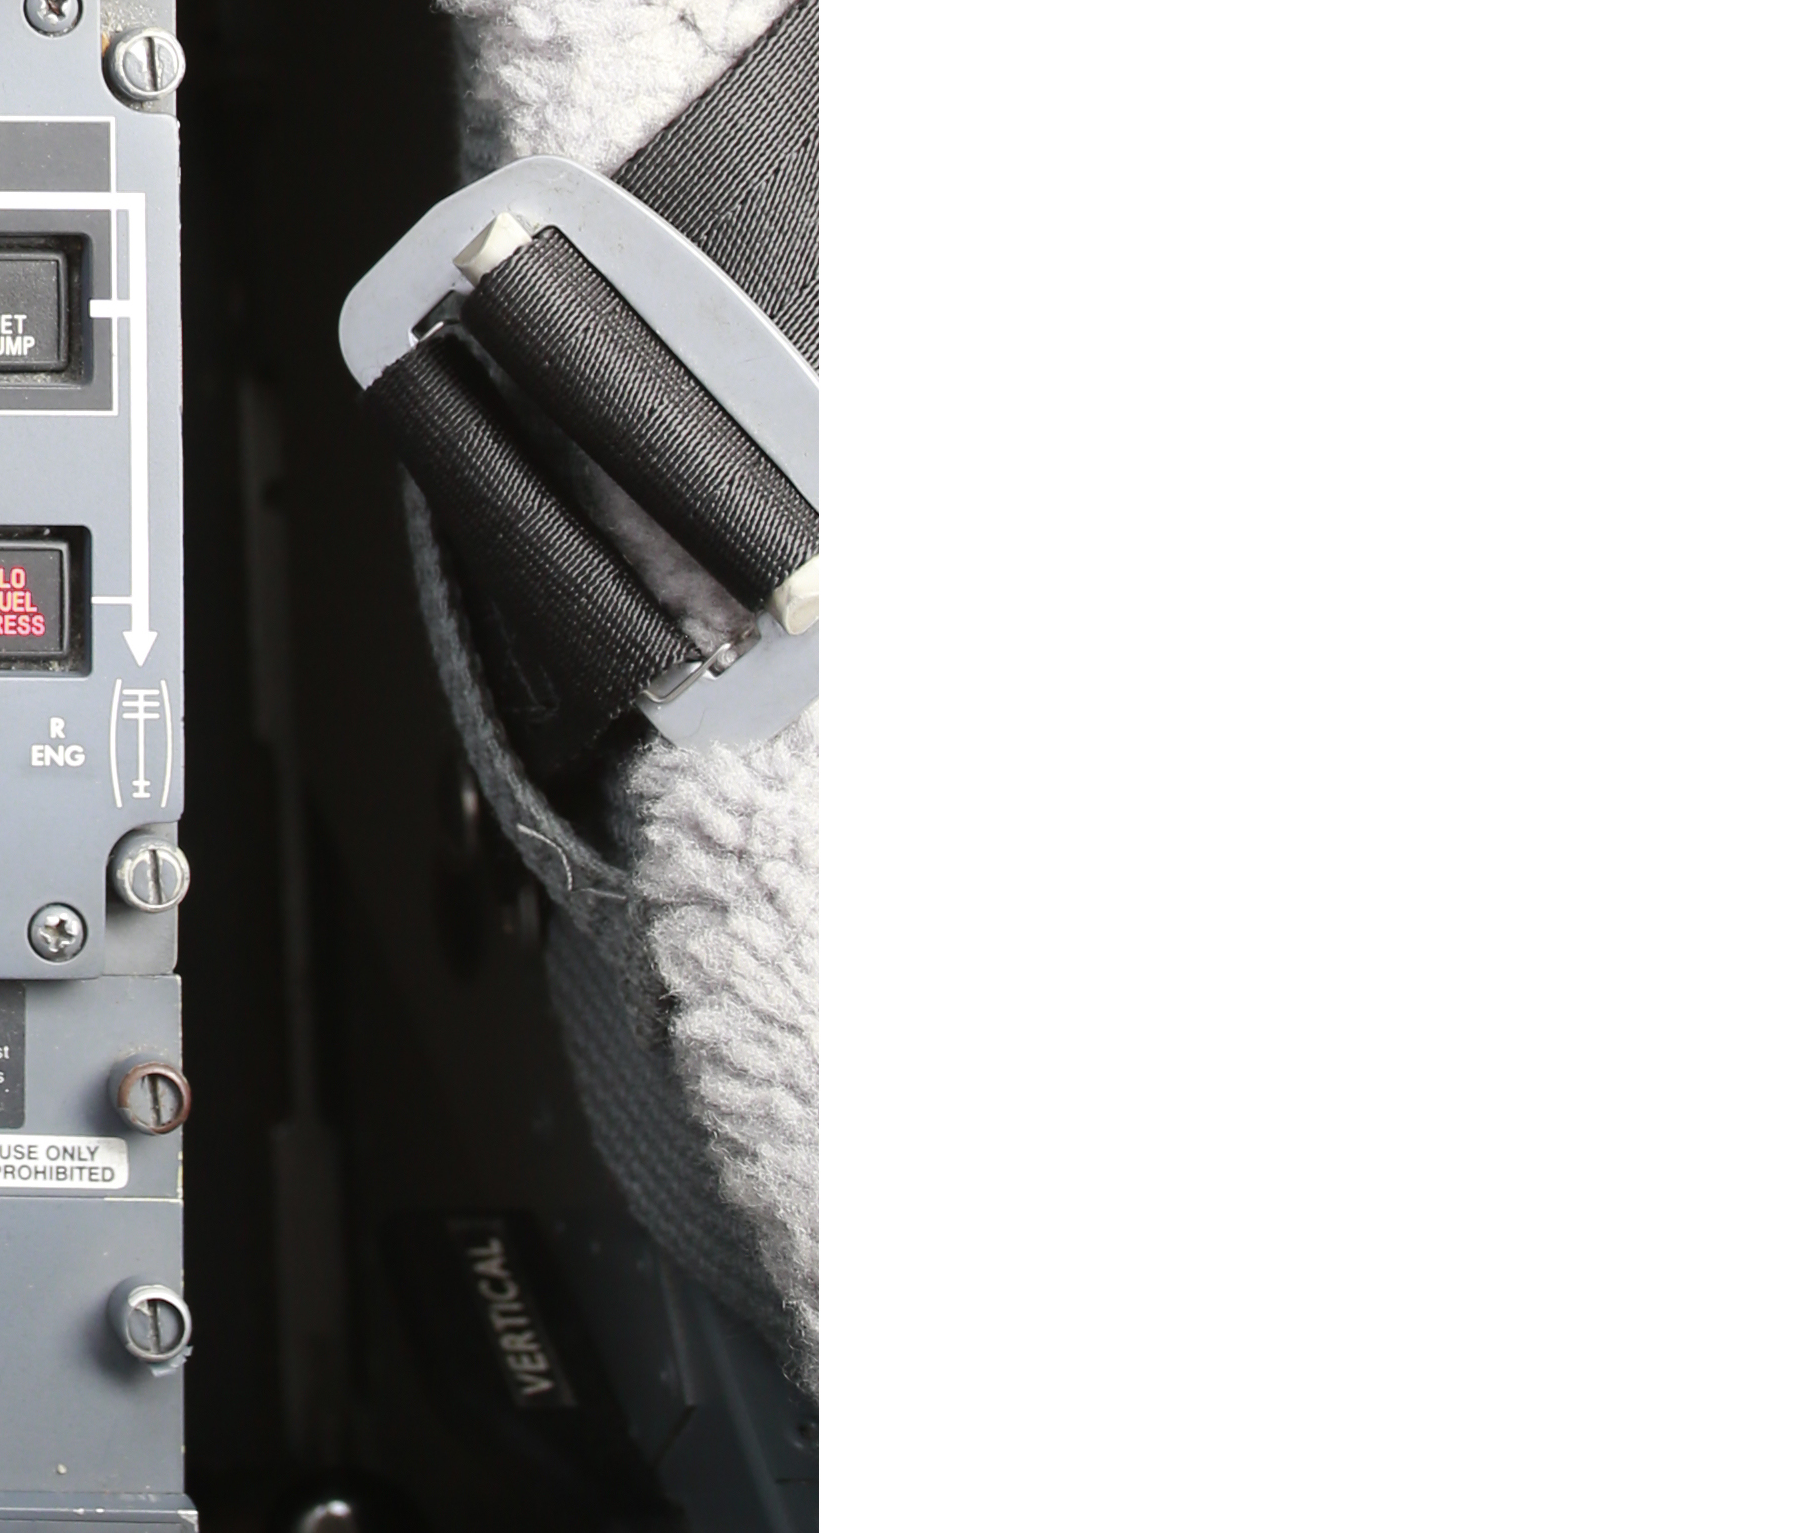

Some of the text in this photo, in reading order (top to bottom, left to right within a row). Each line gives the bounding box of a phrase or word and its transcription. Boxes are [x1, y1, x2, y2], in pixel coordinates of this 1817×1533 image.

[0, 1144, 38, 1160] USE
[46, 1145, 99, 1161] ONLY
[467, 1237, 553, 1398] VERTICAL
